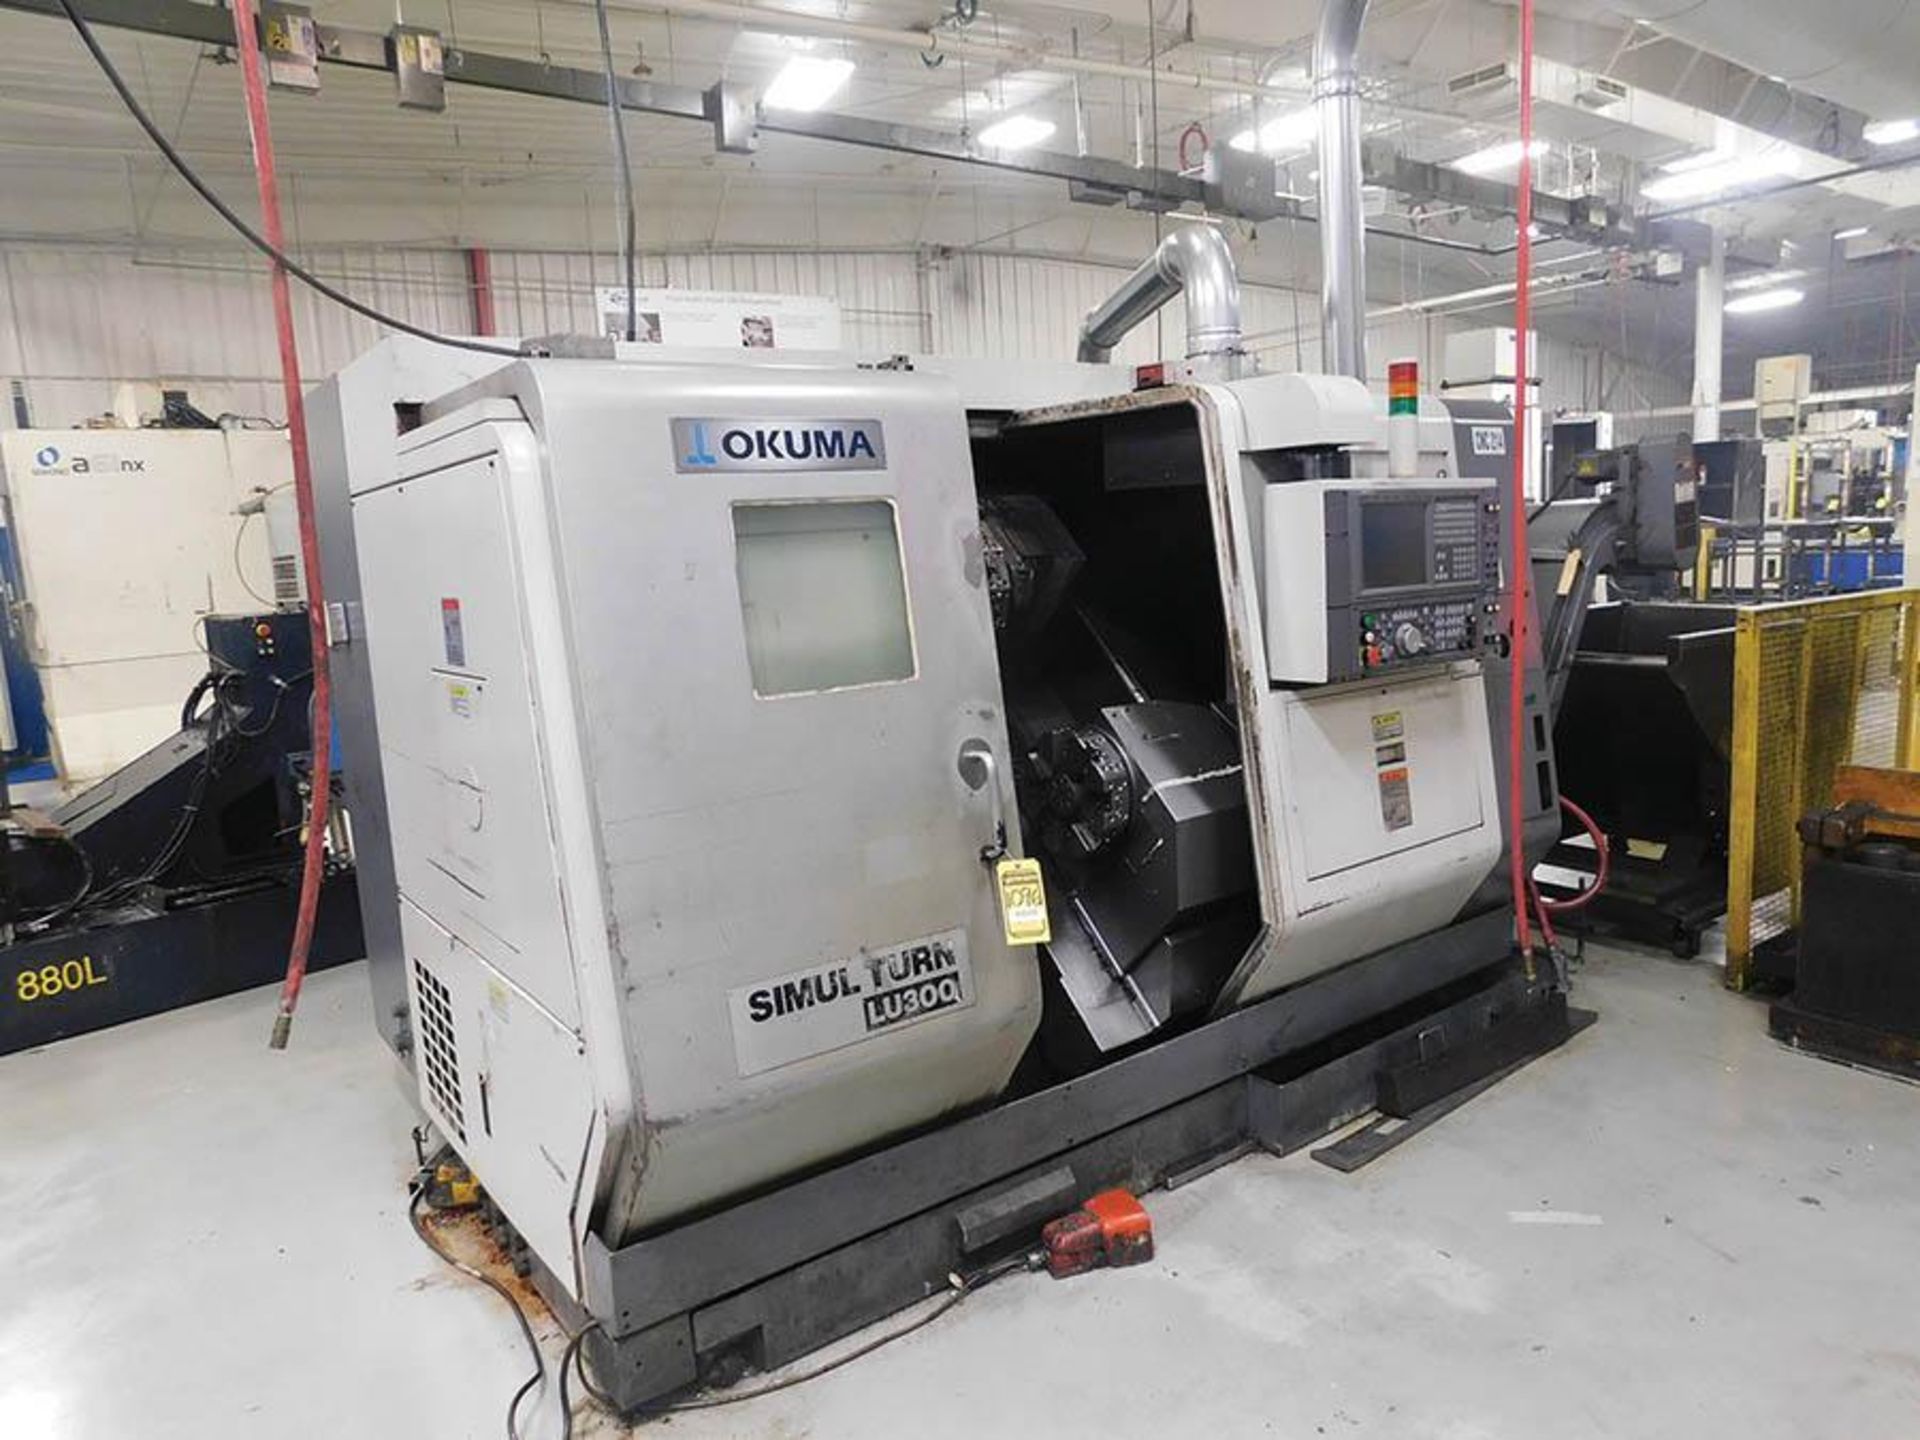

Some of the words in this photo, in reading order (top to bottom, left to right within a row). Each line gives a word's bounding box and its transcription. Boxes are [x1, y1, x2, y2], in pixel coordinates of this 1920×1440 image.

[722, 430, 876, 459] OKUMA
[17, 955, 108, 1001] 880L
[748, 967, 861, 1022] SIMUL
[866, 942, 957, 988] TURN
[866, 977, 961, 1026] LU300
